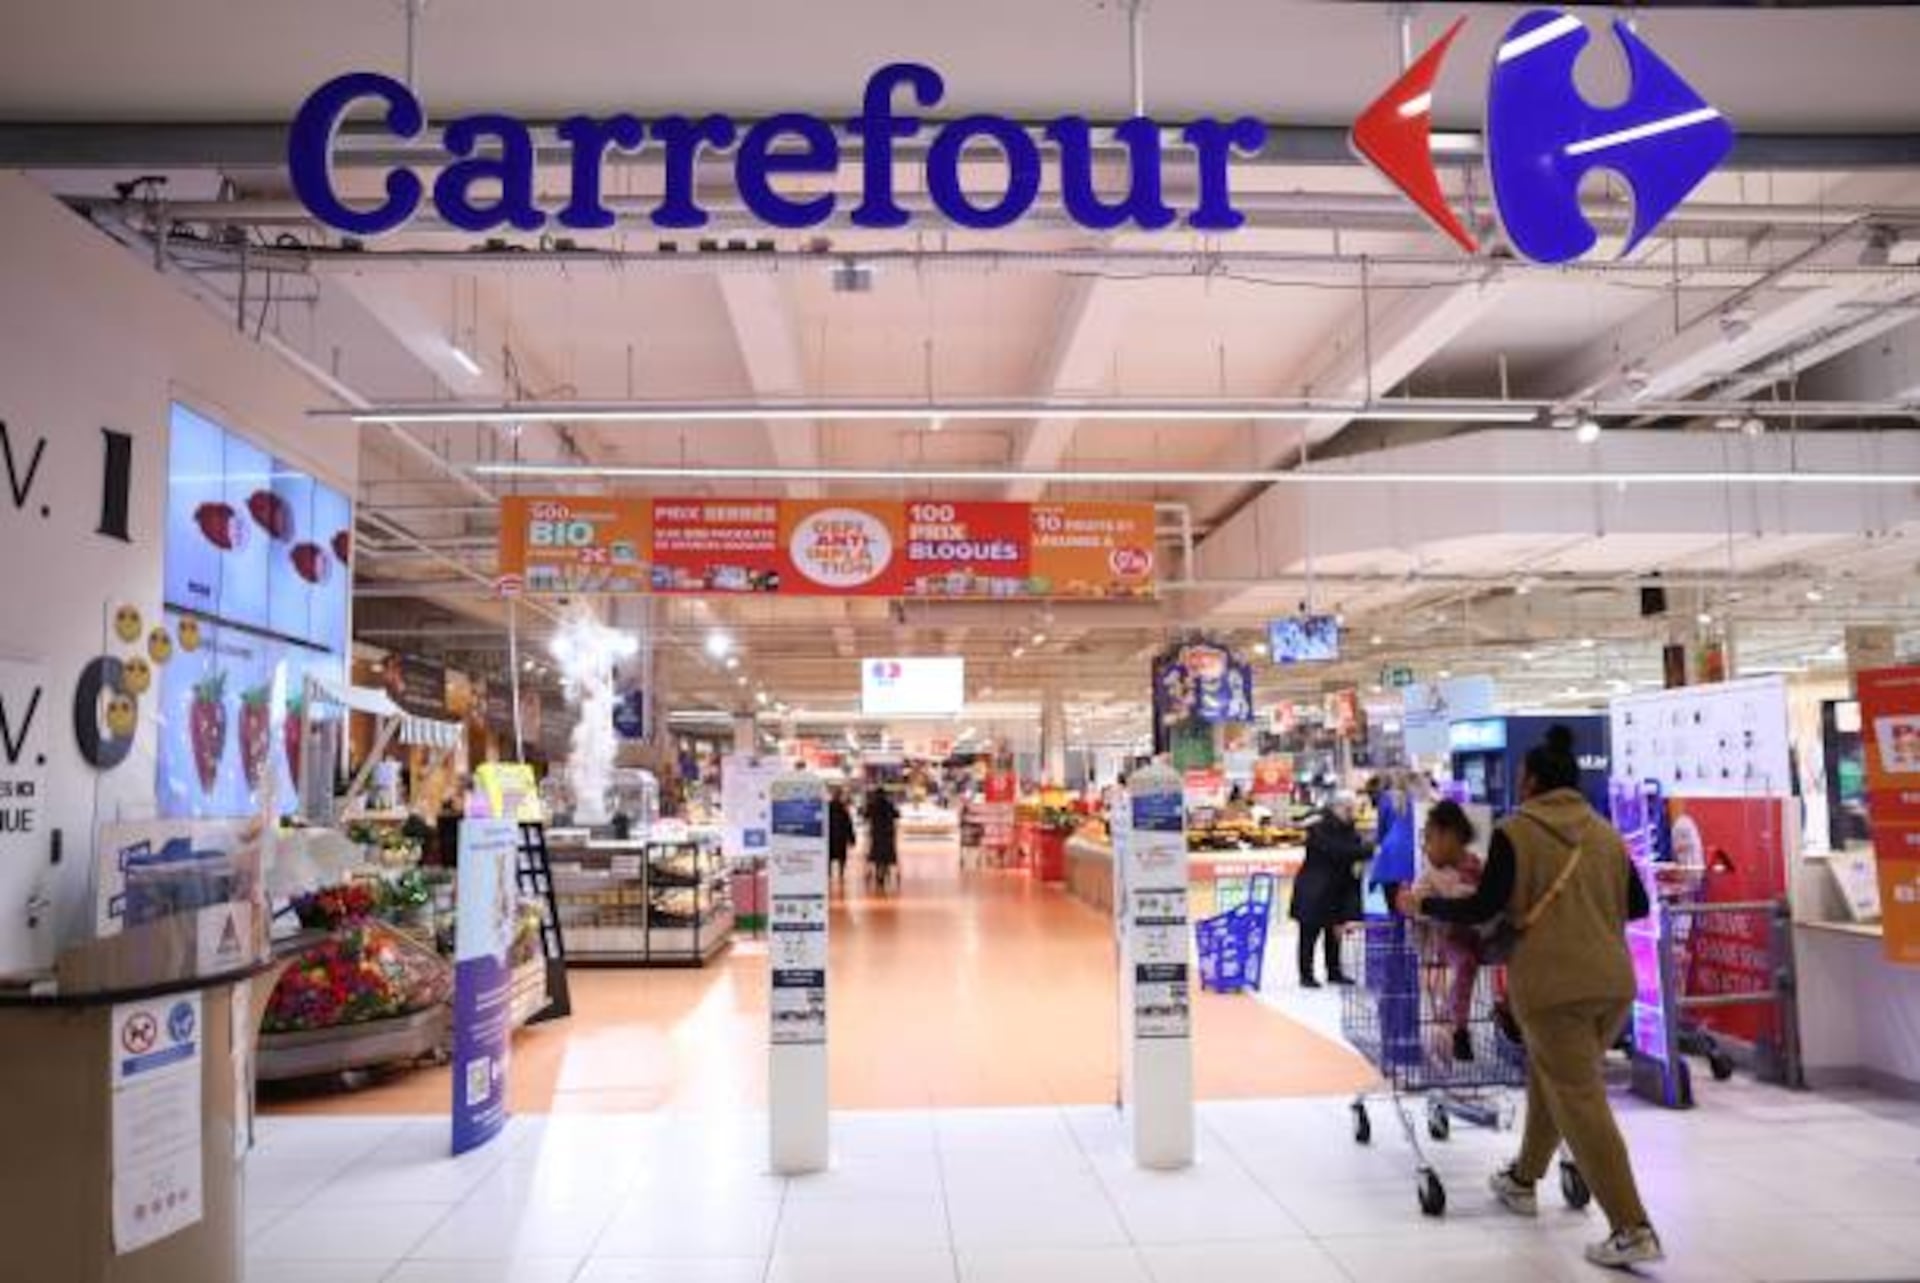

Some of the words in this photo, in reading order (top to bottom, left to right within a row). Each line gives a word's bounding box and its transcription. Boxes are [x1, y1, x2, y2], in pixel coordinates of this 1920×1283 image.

[288, 63, 1267, 235] Carrefour
[655, 507, 699, 520] PRIX
[910, 503, 955, 522] 100
[529, 521, 594, 546] BIO
[909, 521, 967, 541] PRIX
[909, 538, 1019, 560] BLOQUÉS
